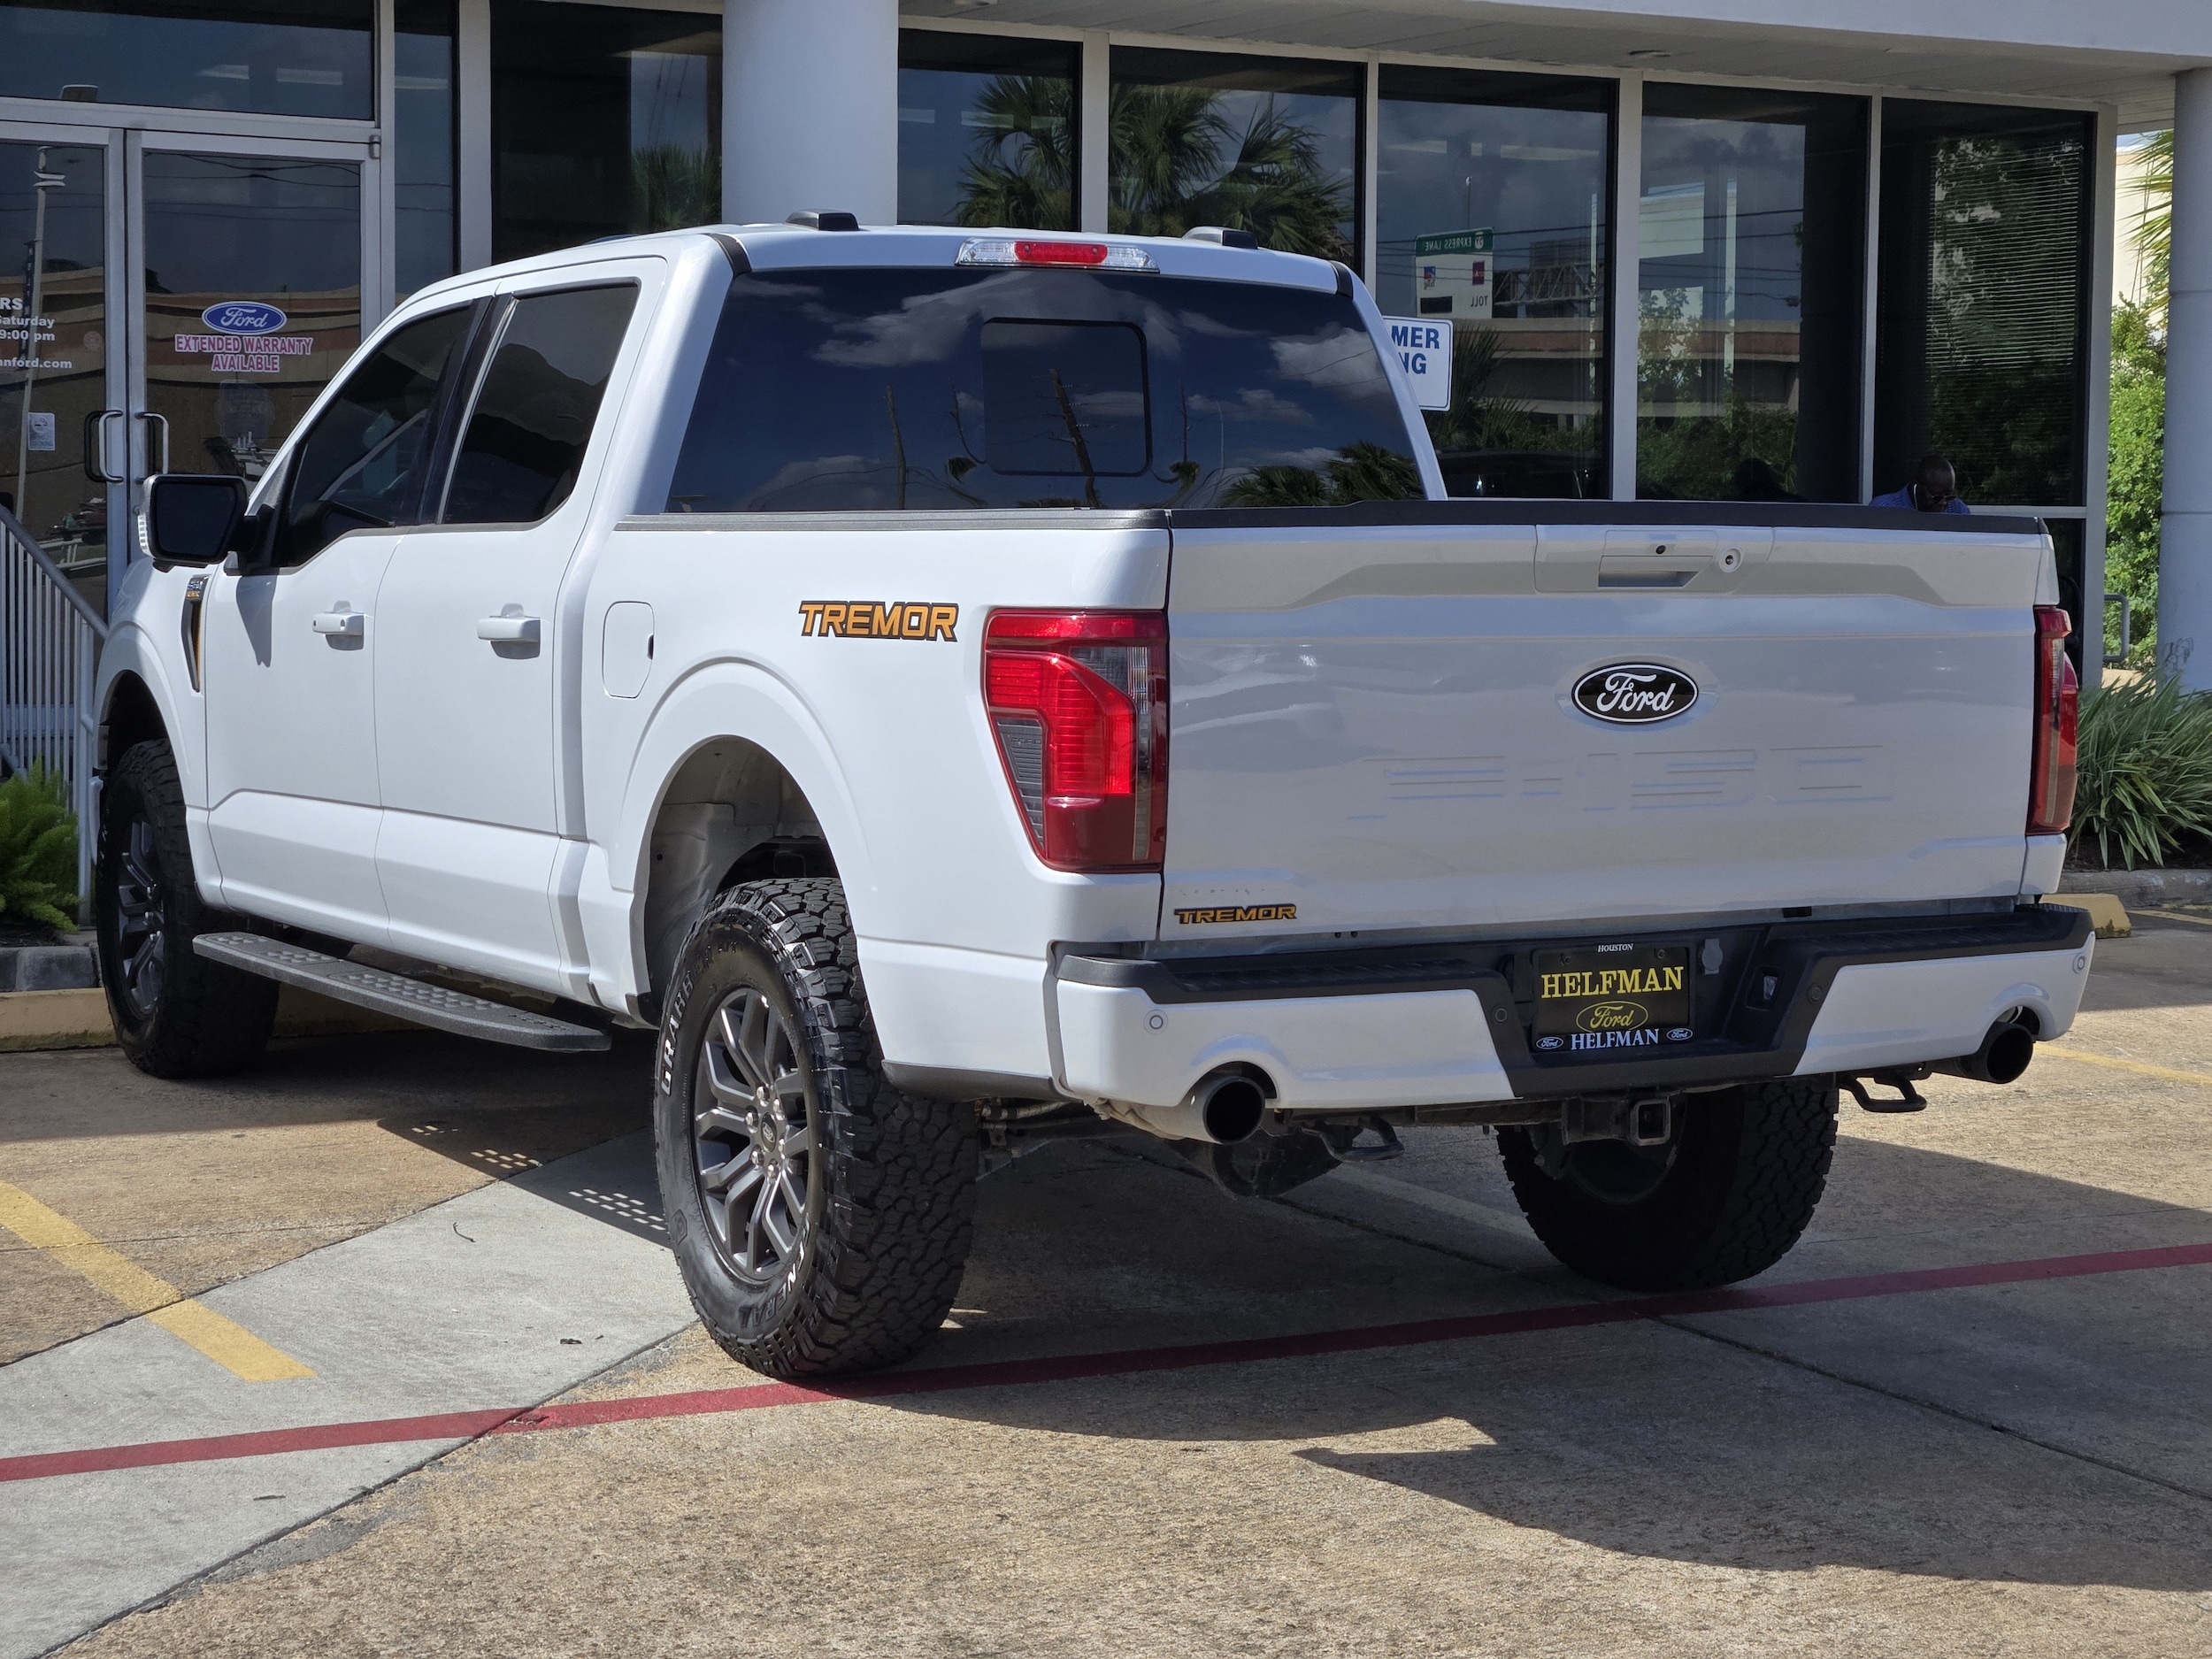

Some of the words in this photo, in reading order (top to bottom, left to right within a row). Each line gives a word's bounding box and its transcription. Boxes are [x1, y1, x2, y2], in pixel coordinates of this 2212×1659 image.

[220, 308, 269, 328] Ford
[34, 333, 55, 342] pm
[175, 334, 241, 353] EXTENDED
[244, 336, 313, 355] WARRANTY
[211, 355, 280, 373] AVAILABLE
[799, 601, 959, 642] TREMOR
[1596, 672, 1677, 712] Ford
[1174, 903, 1297, 925] TREMOR
[1597, 943, 1634, 953] HOUSTON
[1540, 966, 1684, 999] HELFMAN
[1589, 1005, 1635, 1029] Ford
[1571, 1028, 1660, 1050] HELFMAN
